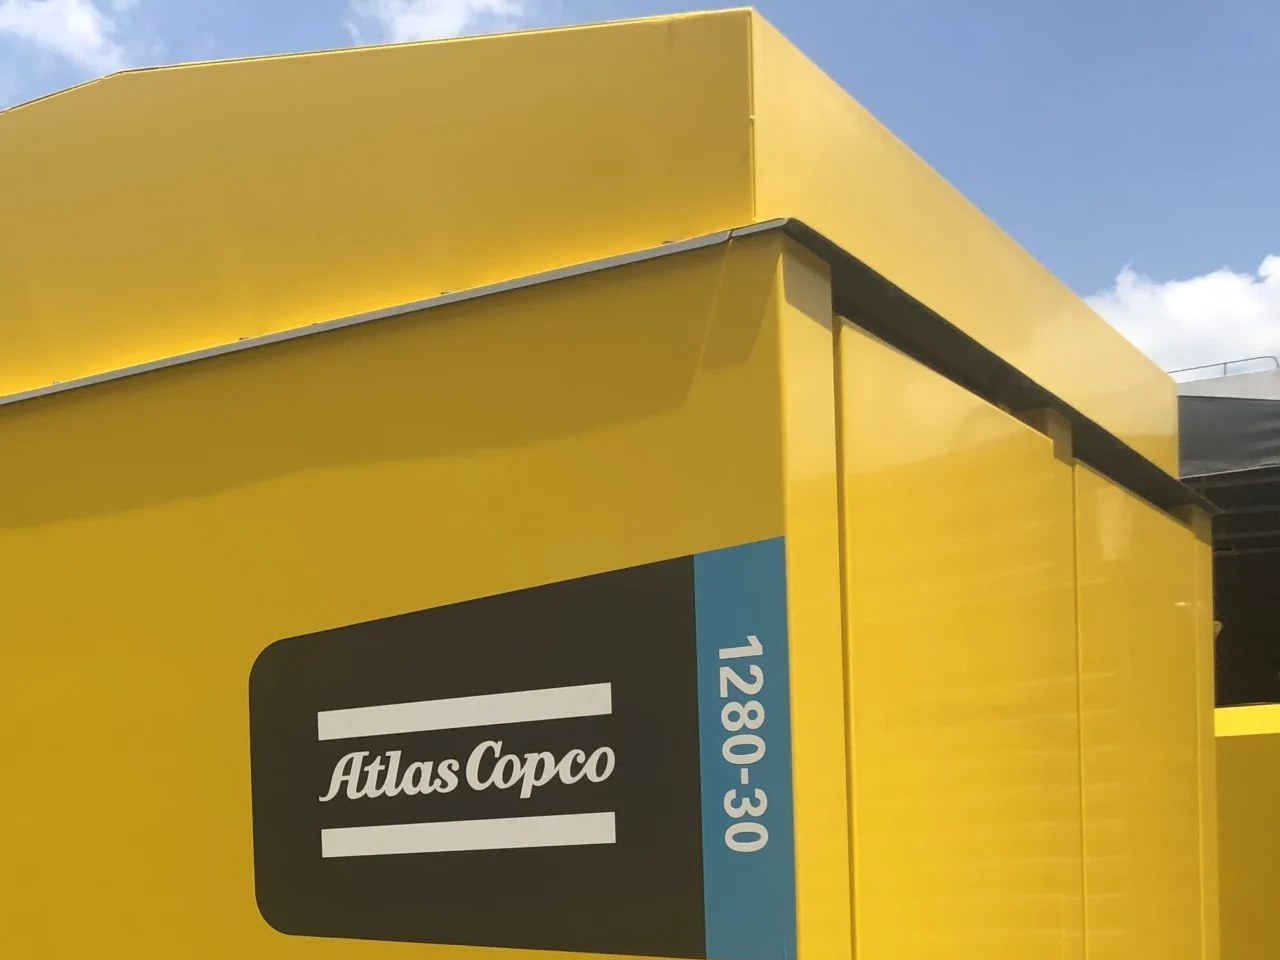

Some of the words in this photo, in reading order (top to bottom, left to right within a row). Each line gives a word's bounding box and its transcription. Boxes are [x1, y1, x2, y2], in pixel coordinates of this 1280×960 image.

[318, 750, 460, 802] Atlas
[465, 740, 616, 799] Copco
[718, 634, 770, 853] 1280-30
